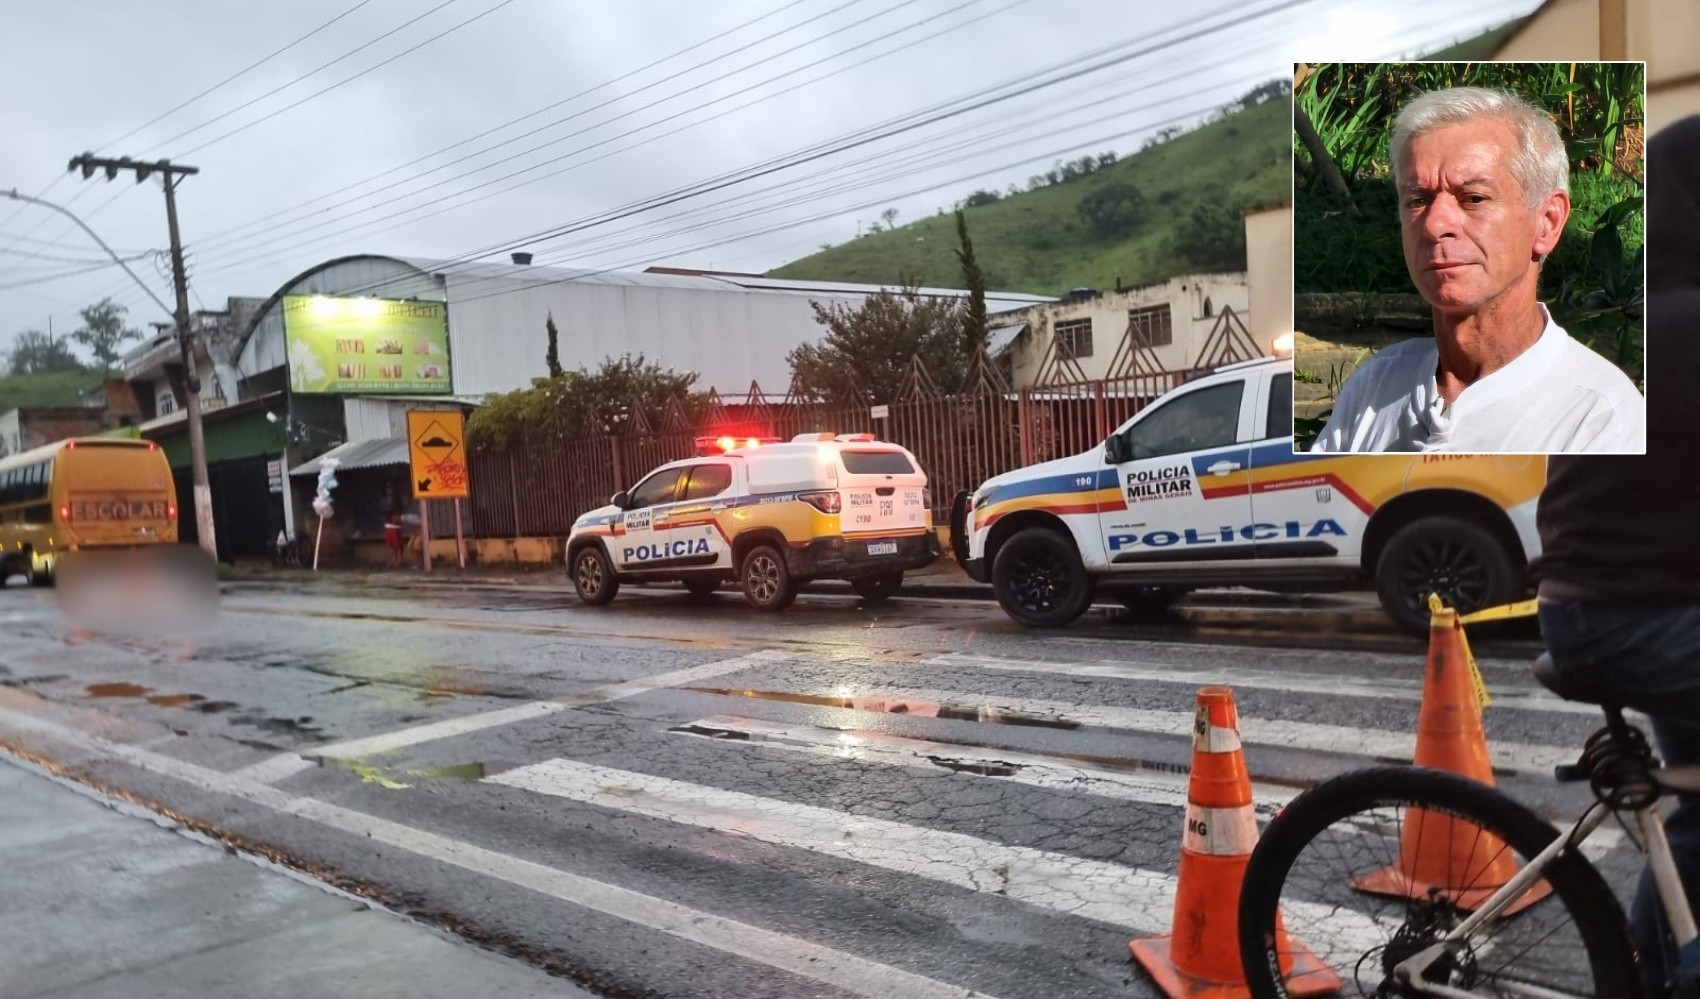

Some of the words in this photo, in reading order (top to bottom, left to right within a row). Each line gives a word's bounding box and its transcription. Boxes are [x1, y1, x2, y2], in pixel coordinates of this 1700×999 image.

[1076, 476, 1092, 486] 190
[1127, 479, 1191, 498] MILITAR
[1140, 494, 1164, 502] MINAS
[1166, 491, 1193, 499] GERAIS
[72, 502, 166, 518] ESCOLAR
[1188, 817, 1207, 836] MG
